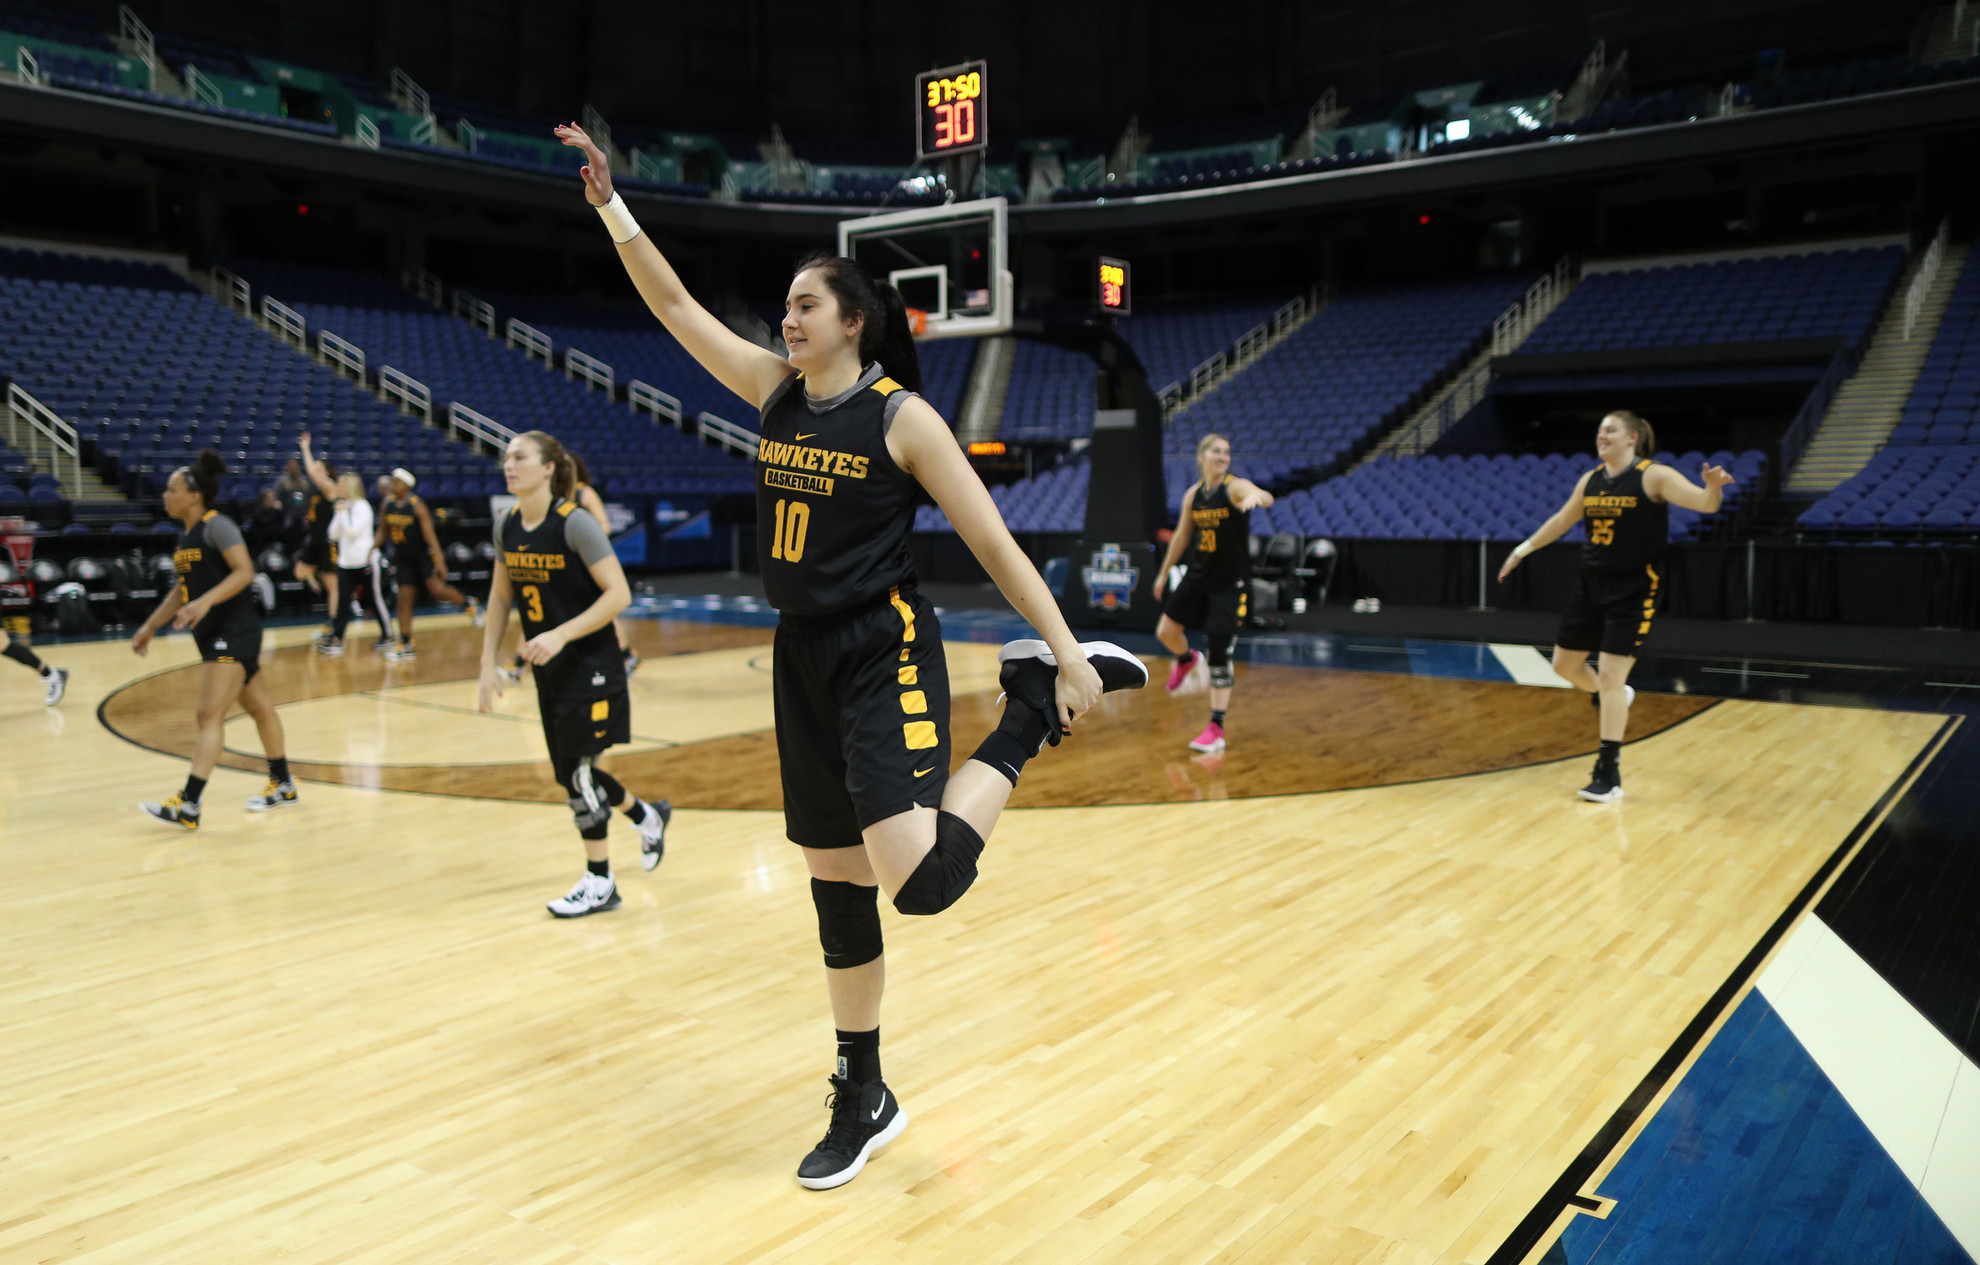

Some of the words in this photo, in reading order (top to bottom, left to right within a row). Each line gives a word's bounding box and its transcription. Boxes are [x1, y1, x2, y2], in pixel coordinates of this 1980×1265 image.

[927, 72, 980, 107] 37:50
[934, 99, 975, 147] 30
[1104, 283, 1121, 307] 30
[758, 438, 870, 479] HAWKEYES
[767, 470, 829, 494] BASKETBALL
[772, 499, 811, 564] 10
[1591, 518, 1616, 546] 25
[504, 551, 567, 570] WKEYES
[522, 585, 544, 622] 3
